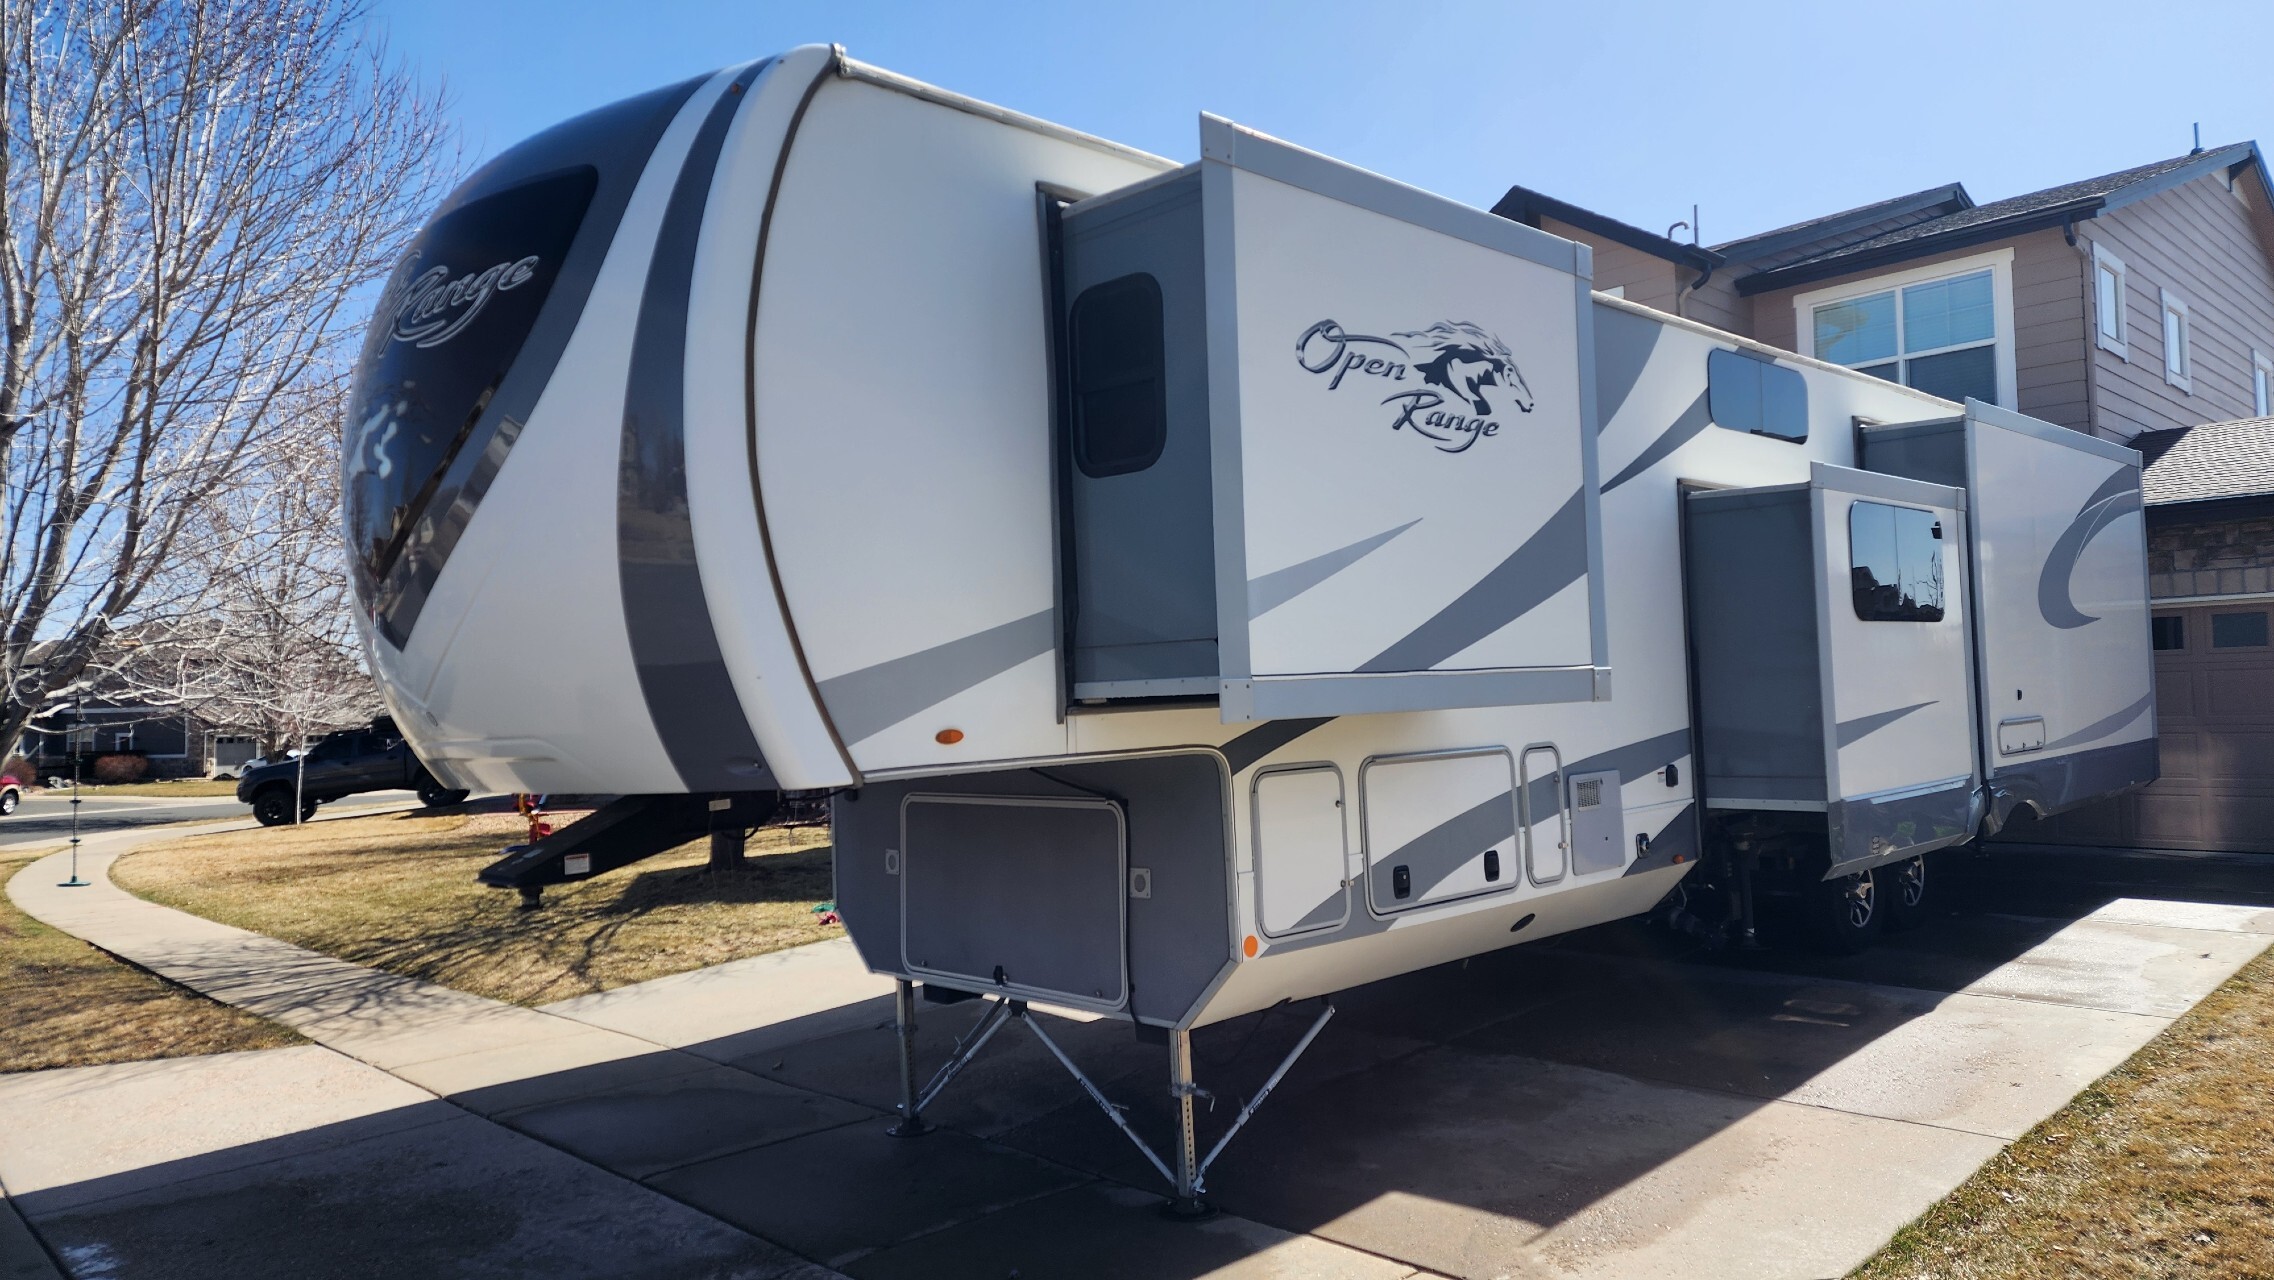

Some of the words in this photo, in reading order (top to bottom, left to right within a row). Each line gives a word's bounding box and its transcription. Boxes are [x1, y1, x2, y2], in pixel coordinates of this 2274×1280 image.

[378, 254, 540, 358] Range
[1295, 319, 1410, 390] Open
[1381, 389, 1500, 453] Range
